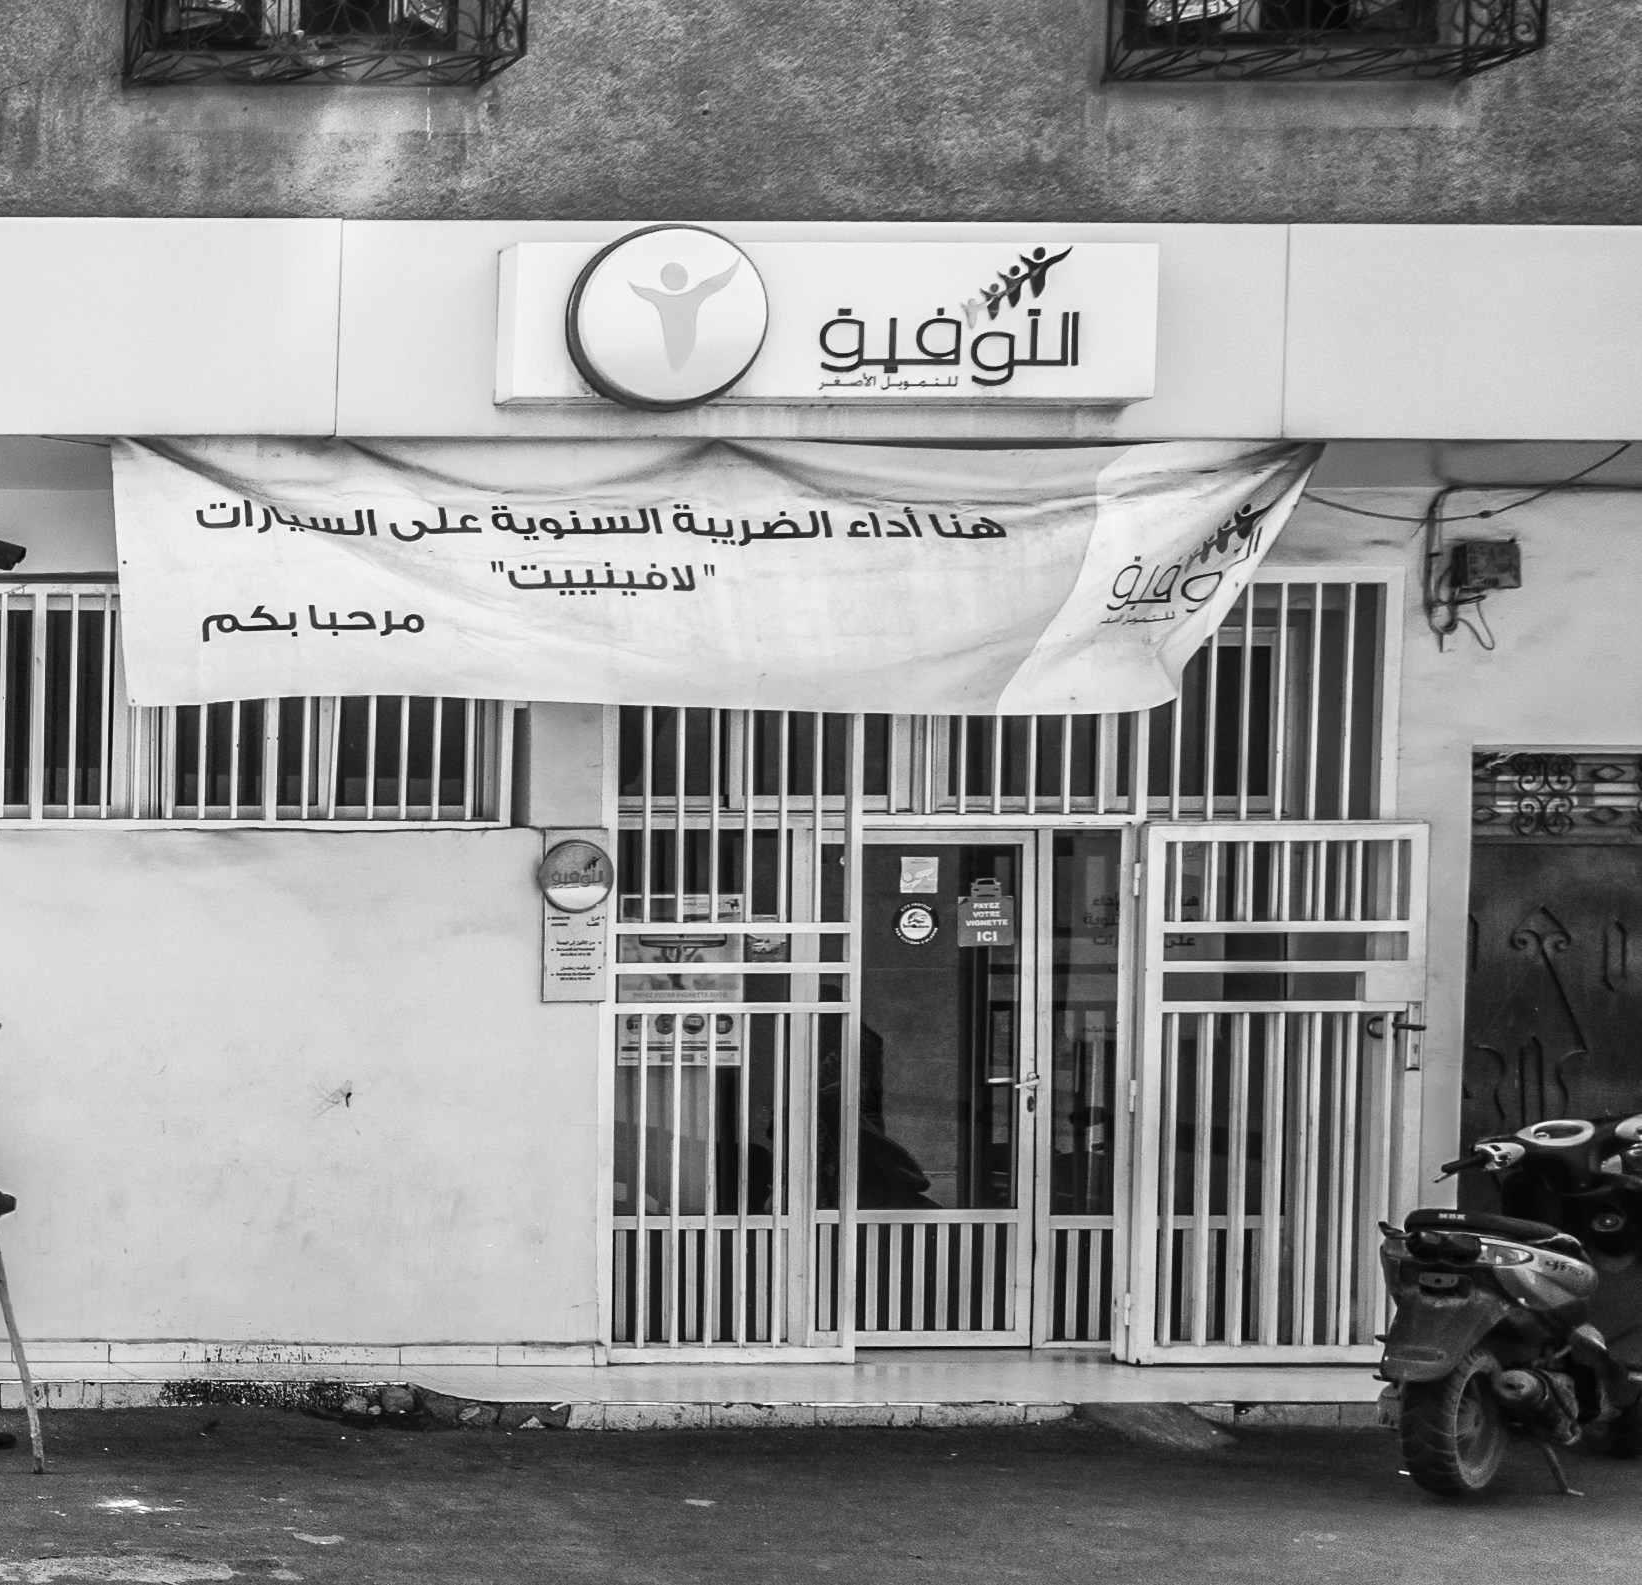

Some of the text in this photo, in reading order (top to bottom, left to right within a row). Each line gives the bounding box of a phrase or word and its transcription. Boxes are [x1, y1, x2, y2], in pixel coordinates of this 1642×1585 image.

[819, 307, 1081, 387] التوفيق
[818, 373, 959, 391] للتمويل الأصغر
[195, 499, 1007, 547] هنا أداء الضريبة السنوية على السيارات
[201, 604, 426, 642] مرحبا بكم
[965, 918, 1009, 927] VIGNETTE
[972, 910, 1001, 918] VOTRE
[976, 930, 998, 942] ICI
